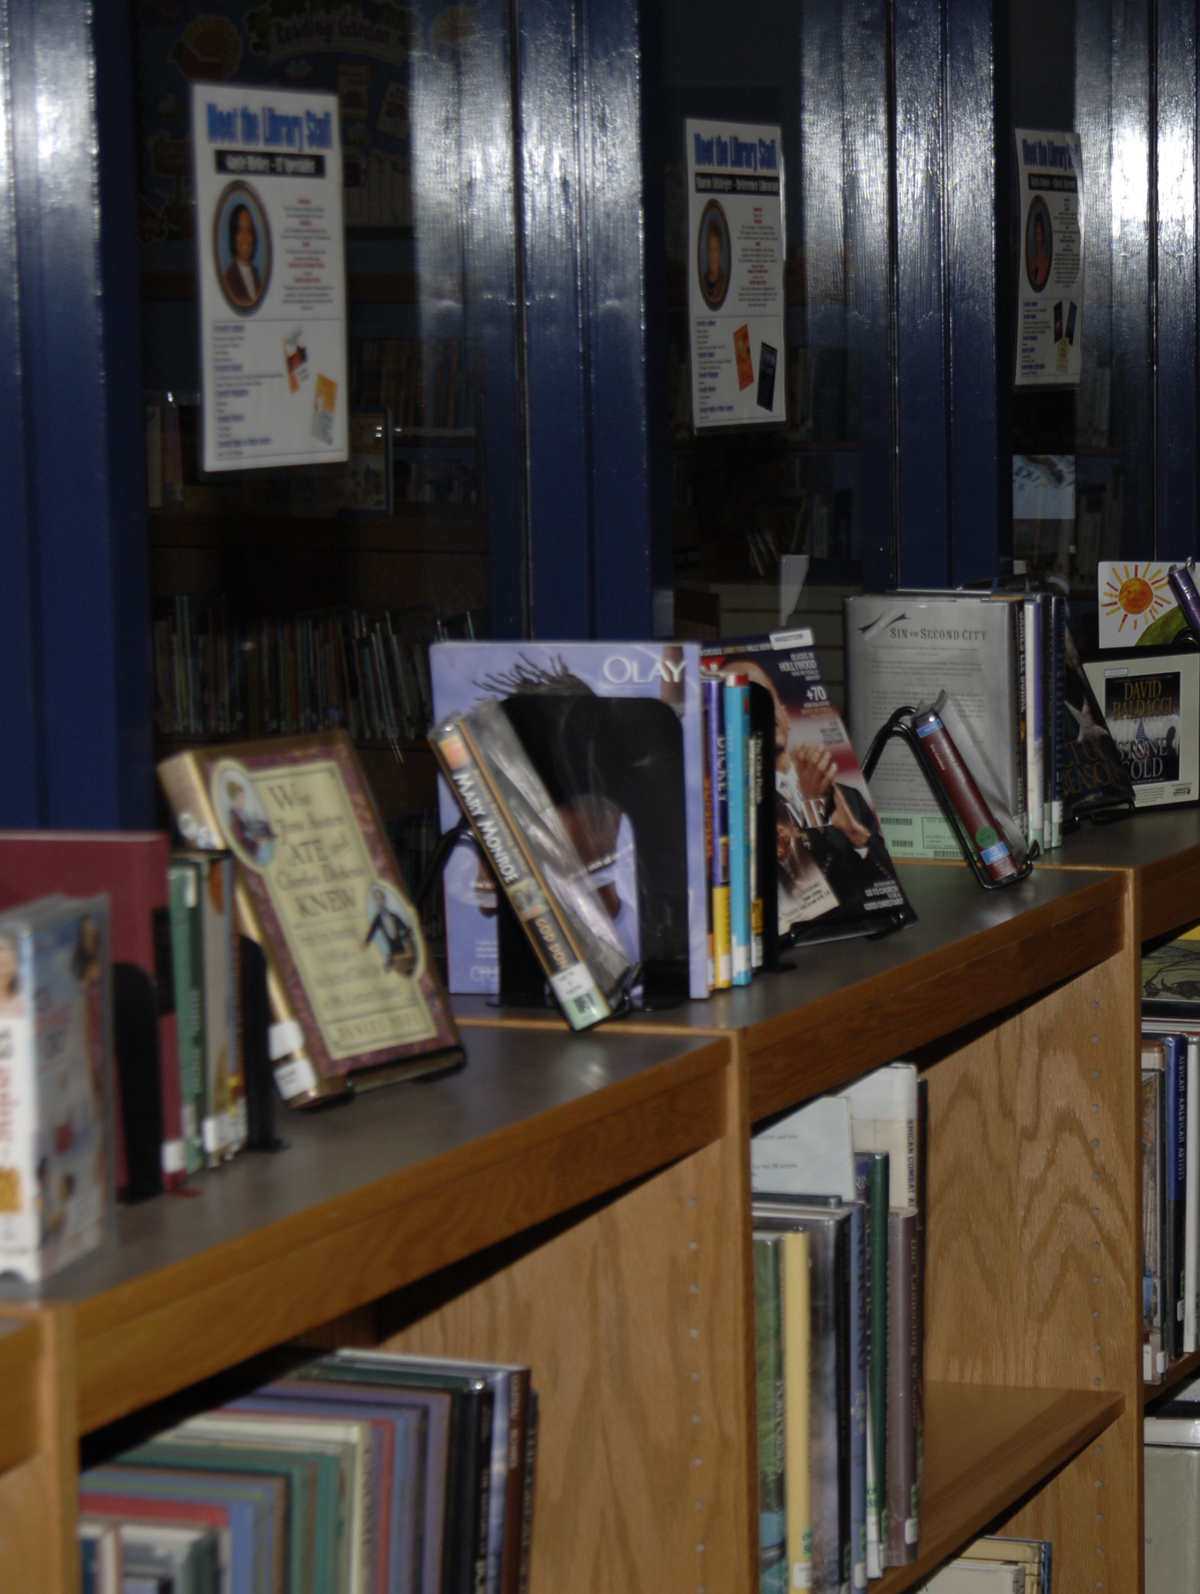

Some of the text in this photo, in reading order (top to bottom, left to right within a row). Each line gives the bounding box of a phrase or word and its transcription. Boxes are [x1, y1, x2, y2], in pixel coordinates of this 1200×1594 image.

[890, 628, 987, 641] SIN SECOND CITY
[603, 657, 687, 683] OLAY
[806, 686, 827, 701] +70
[1124, 680, 1162, 701] DAVID
[1112, 696, 1173, 721] BALDACCI
[1118, 738, 1168, 760] STONE
[453, 771, 519, 884] MARY MONROE
[534, 917, 570, 971] GOD DON
[1178, 1055, 1186, 1143] AFRICAN-AMERICAN
